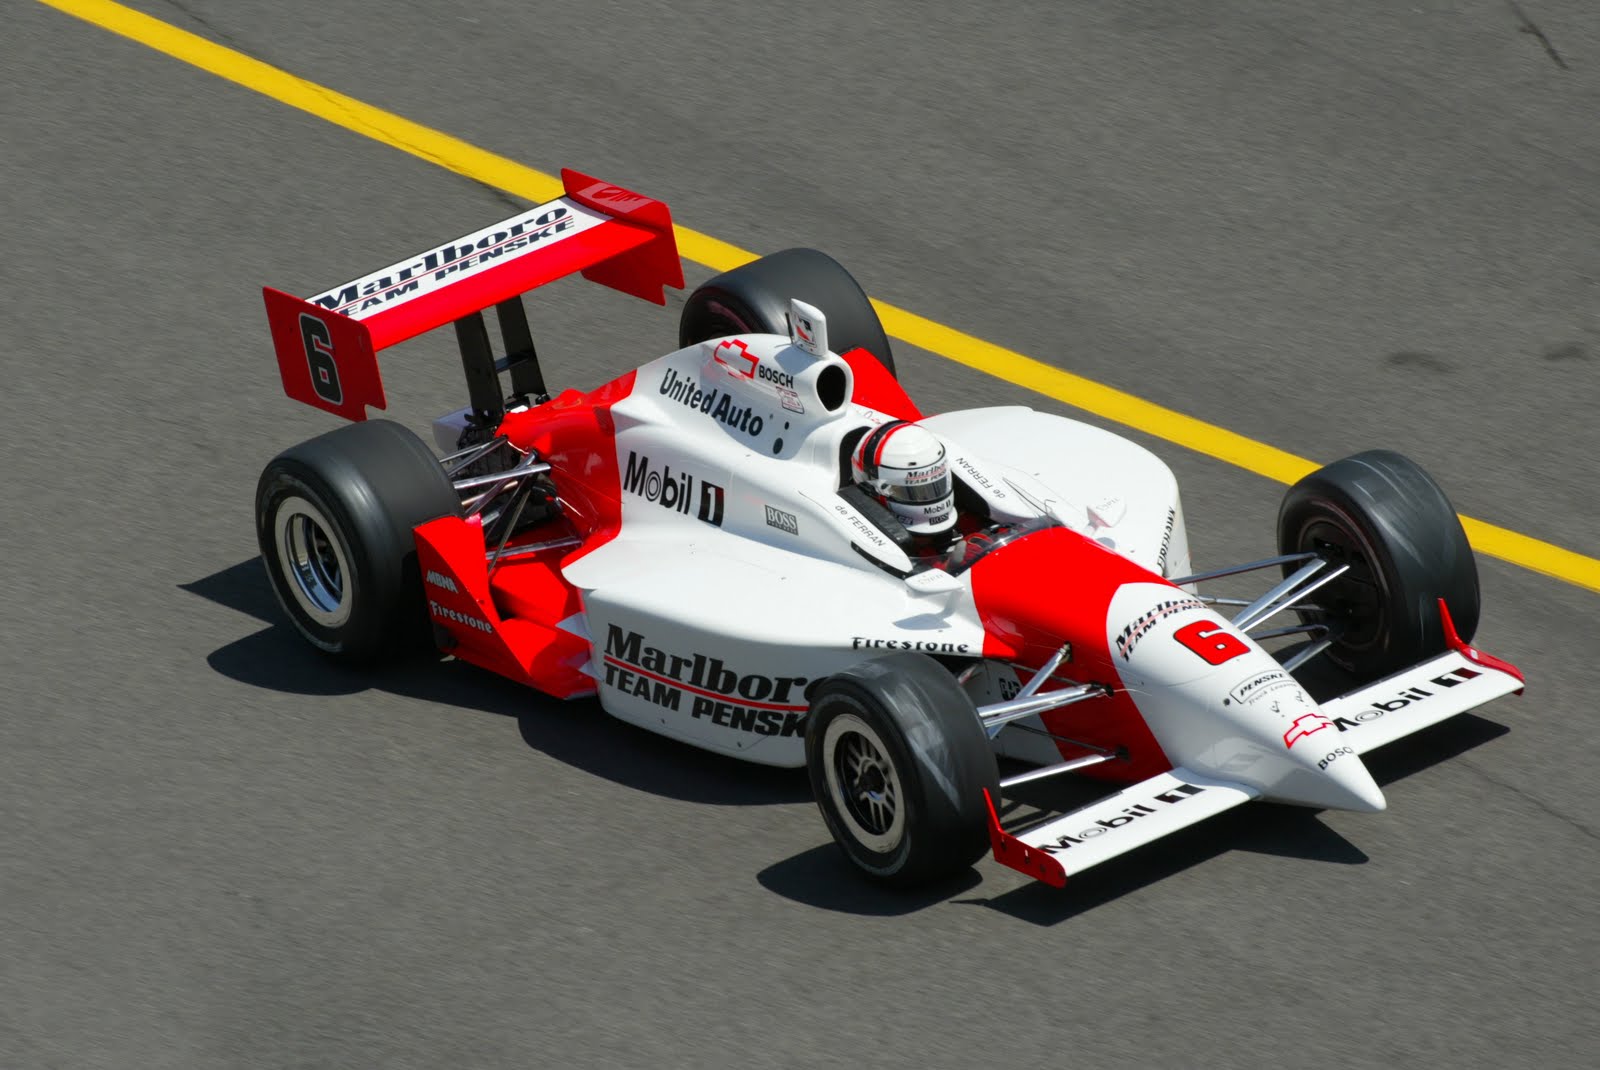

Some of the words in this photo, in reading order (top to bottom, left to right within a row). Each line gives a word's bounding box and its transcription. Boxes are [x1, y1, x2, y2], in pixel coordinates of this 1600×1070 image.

[313, 207, 567, 309] Marlboro
[339, 281, 419, 316] EAM
[435, 217, 575, 281] PENSKE
[299, 312, 343, 405] 6
[758, 365, 794, 388] BOSCH
[659, 367, 764, 437] UnitedAuto
[623, 450, 693, 515] Mobil
[955, 457, 993, 489] FERRAN
[923, 502, 945, 515] Mobil
[993, 489, 1006, 499] de
[767, 507, 797, 530] BOSS
[835, 505, 848, 515] de
[848, 516, 886, 546] FERRAN
[426, 570, 459, 594] MBNA
[430, 600, 493, 634] Firestone
[851, 637, 969, 653] Firestone
[1173, 620, 1251, 666] 6
[603, 662, 681, 711] TEAM
[691, 696, 807, 738] PENSK
[1317, 746, 1355, 770] BOSC
[1039, 804, 1157, 855] Mobil
